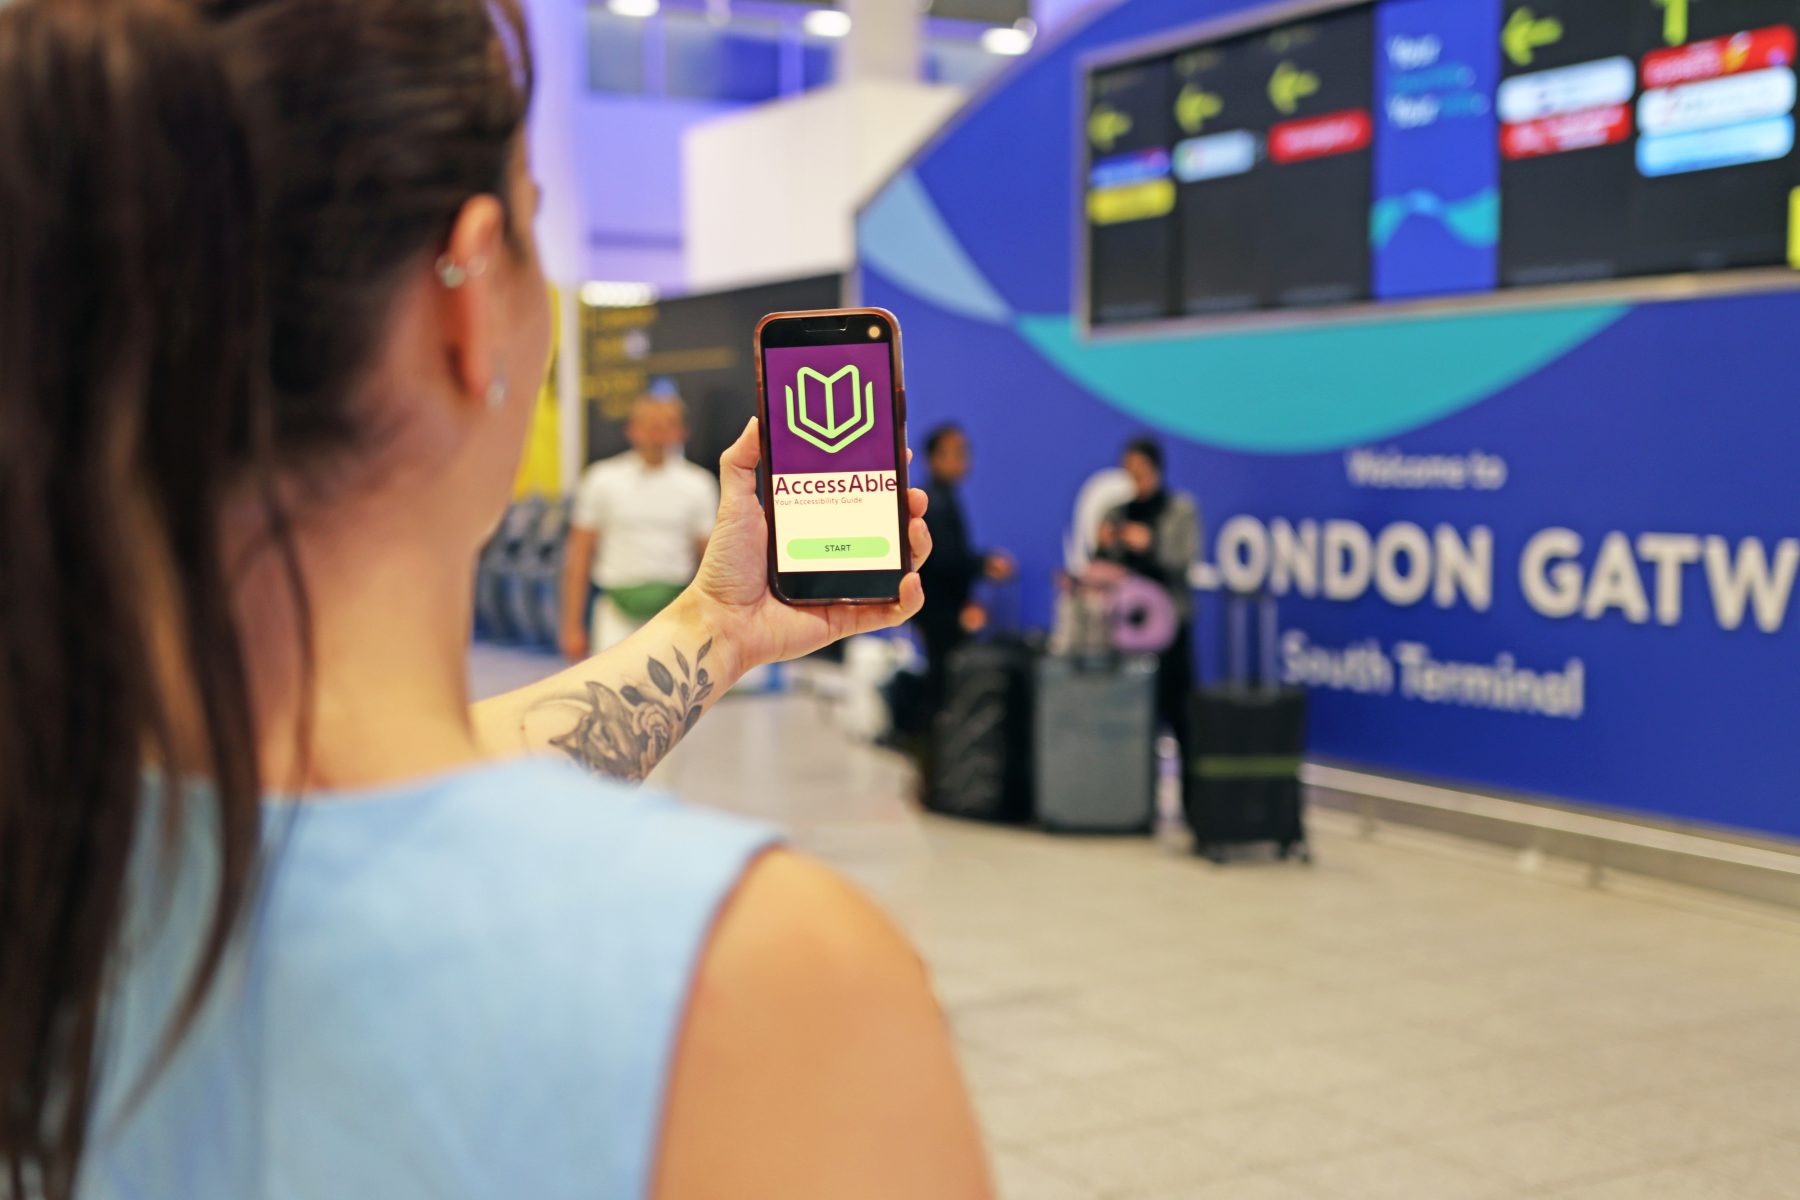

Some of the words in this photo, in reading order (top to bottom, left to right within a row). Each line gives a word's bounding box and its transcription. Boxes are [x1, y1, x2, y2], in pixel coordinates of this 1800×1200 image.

[774, 473, 897, 495] AccessAble
[1347, 449, 1465, 489] Welcome
[840, 496, 863, 504] Guide
[824, 544, 851, 552] START
[1520, 526, 1800, 632] GATW
[1283, 630, 1394, 694] South
[1396, 642, 1584, 719] Terminal
